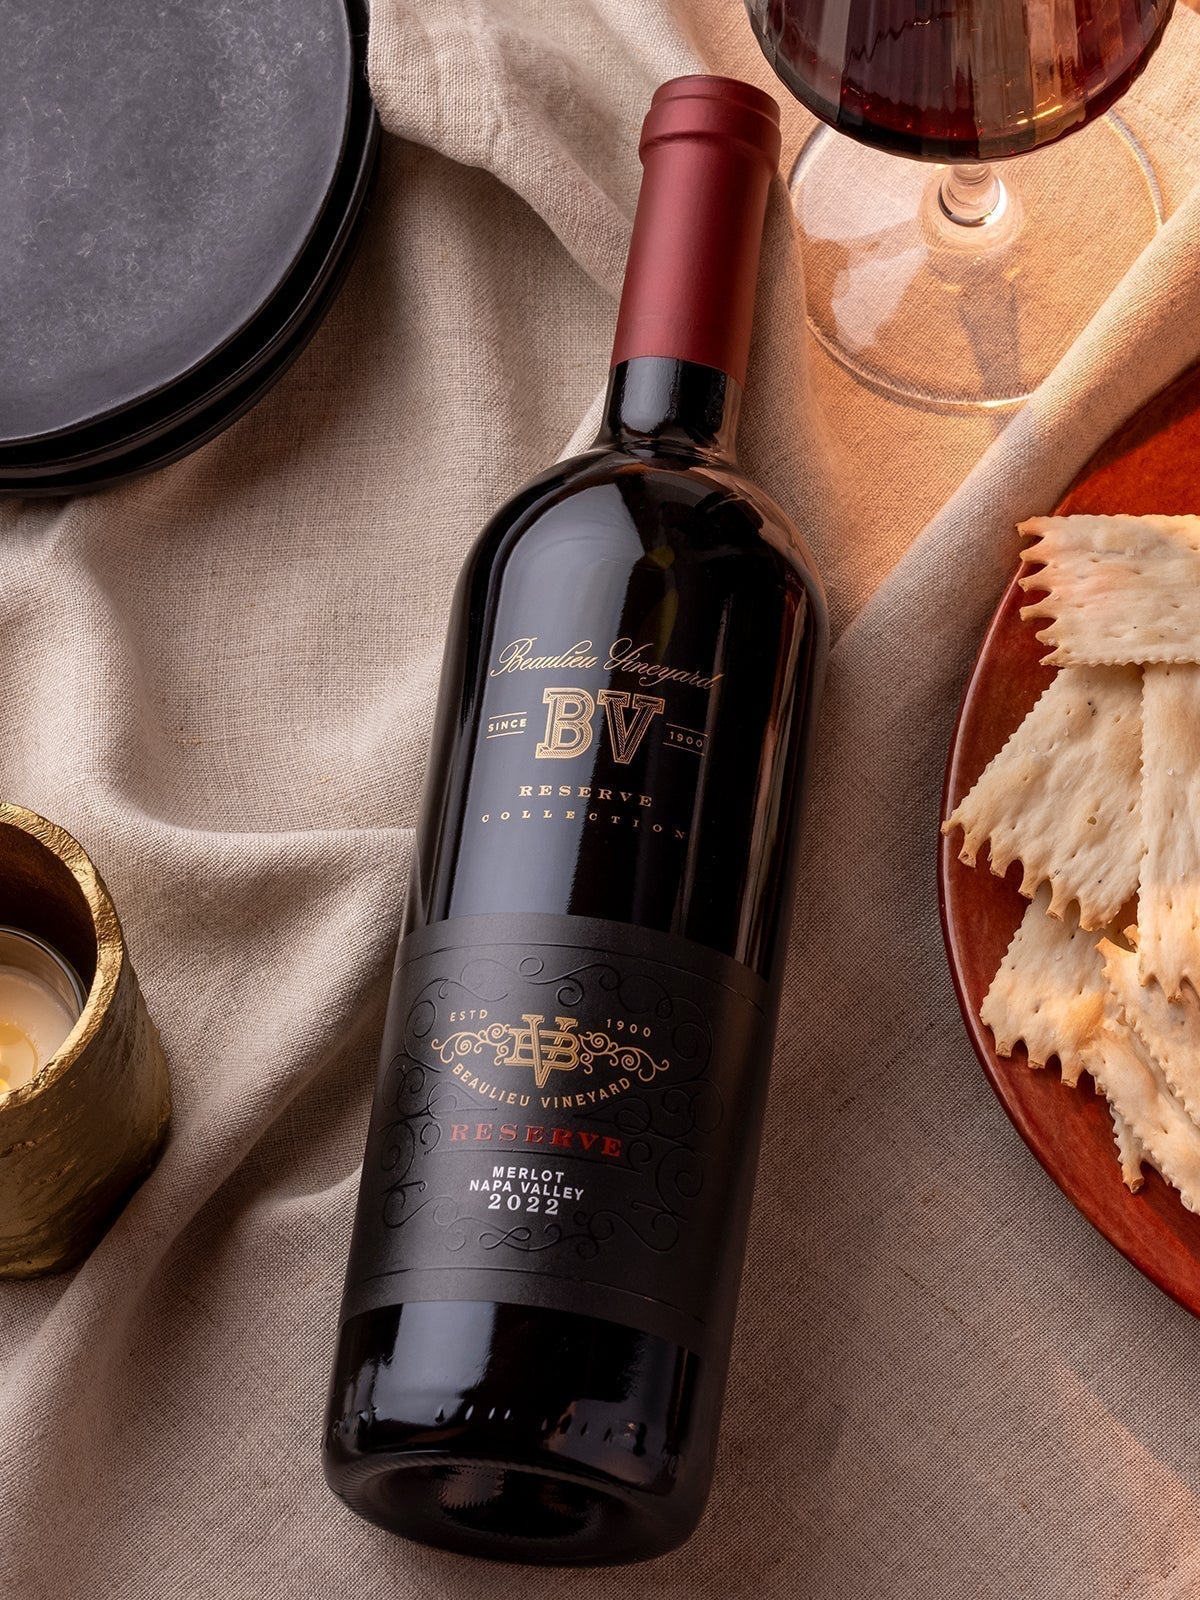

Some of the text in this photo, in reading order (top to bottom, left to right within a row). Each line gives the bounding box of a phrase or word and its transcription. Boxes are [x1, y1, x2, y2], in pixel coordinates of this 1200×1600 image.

[490, 637, 724, 690] Beaulieu Vineyard
[487, 717, 528, 733] SINCE
[535, 687, 666, 765] BV
[669, 730, 704, 748] 1900
[518, 785, 653, 808] RESERVE
[481, 809, 686, 840] COLLECTION
[450, 1009, 489, 1022] ESTD
[606, 1018, 652, 1038] 1900
[452, 1062, 631, 1109] BEAULIEU VINEYARD
[452, 1123, 622, 1158] RESERVE
[492, 1166, 565, 1184] MERLOT
[469, 1179, 585, 1201] NAPA VALLEY
[487, 1193, 559, 1216] 2022
